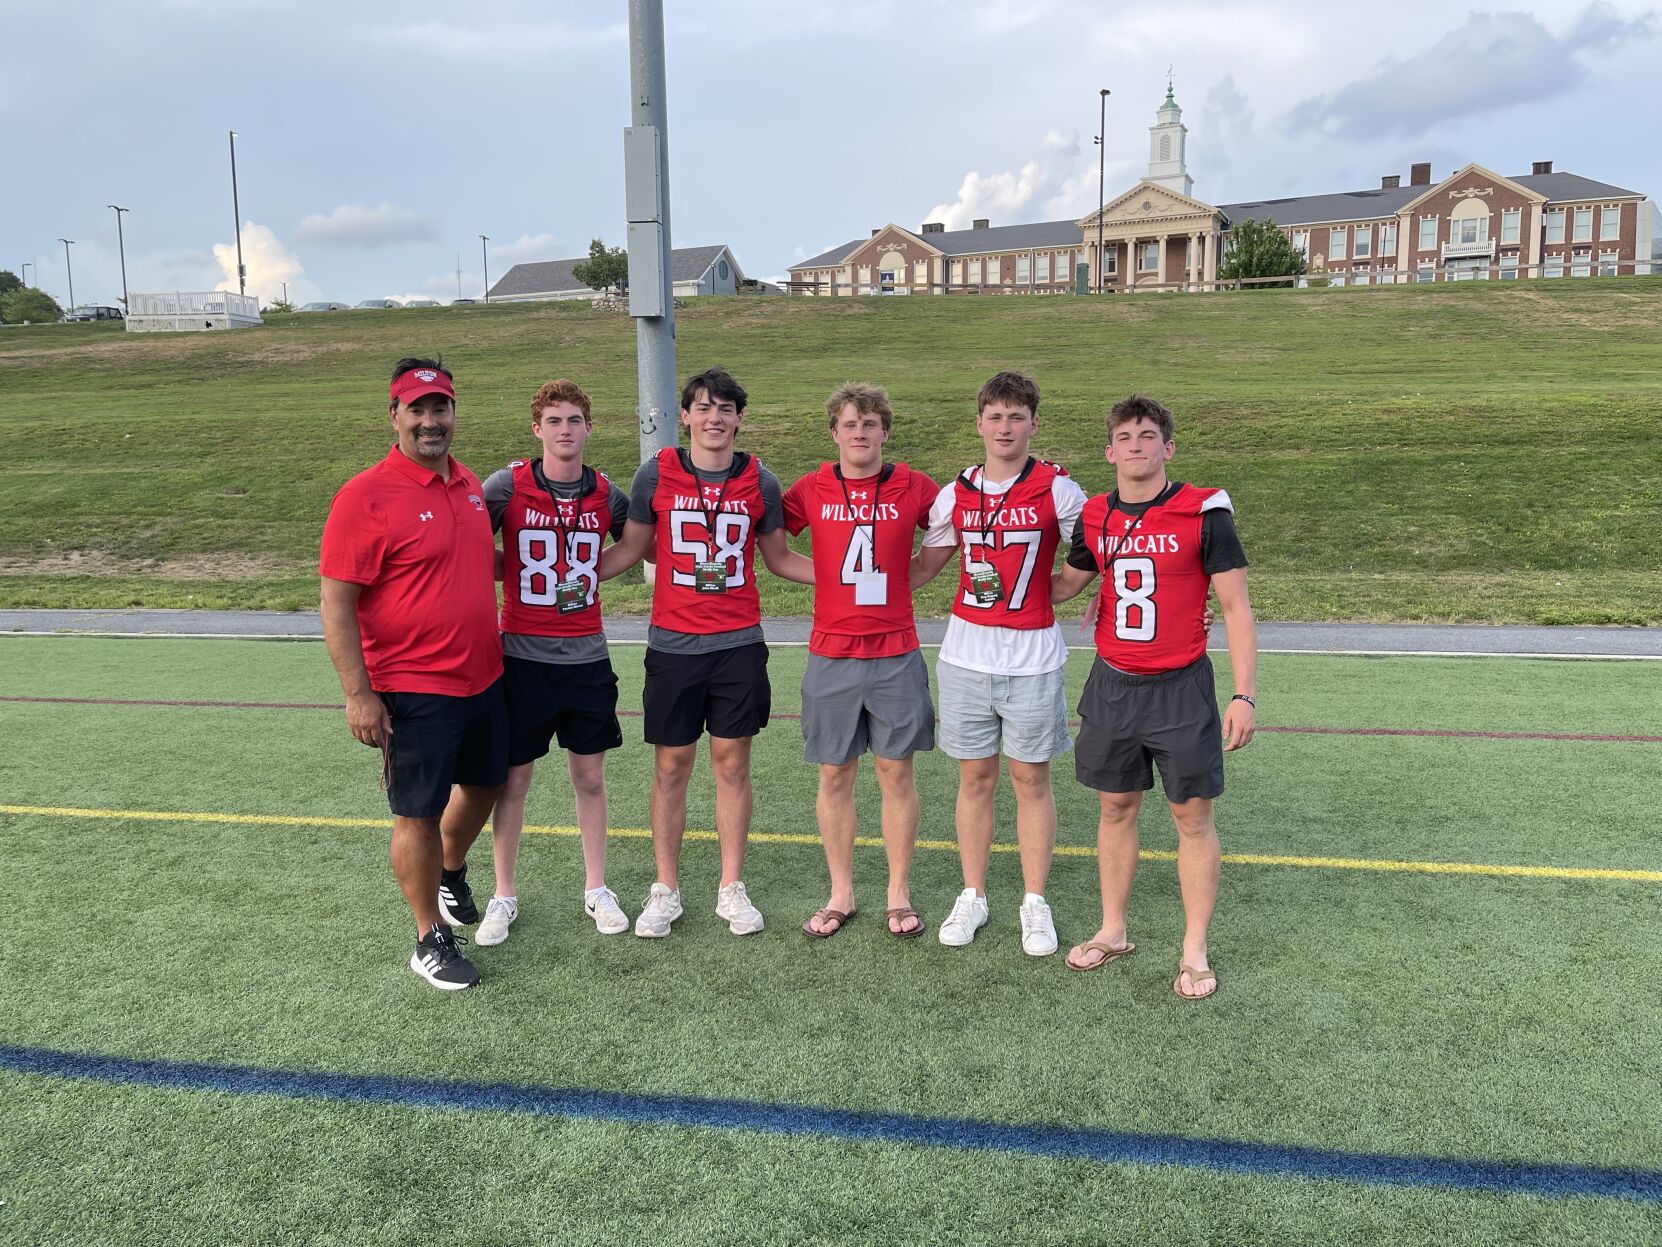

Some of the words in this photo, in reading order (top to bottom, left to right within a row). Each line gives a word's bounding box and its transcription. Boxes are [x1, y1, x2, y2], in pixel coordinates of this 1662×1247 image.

[670, 510, 751, 588] 58
[821, 503, 899, 521] WILDCATS
[1097, 534, 1179, 555] WILDCATS
[518, 528, 601, 606] 88
[840, 524, 881, 585] 4
[961, 529, 1043, 611] 57
[1113, 556, 1157, 642] 8
